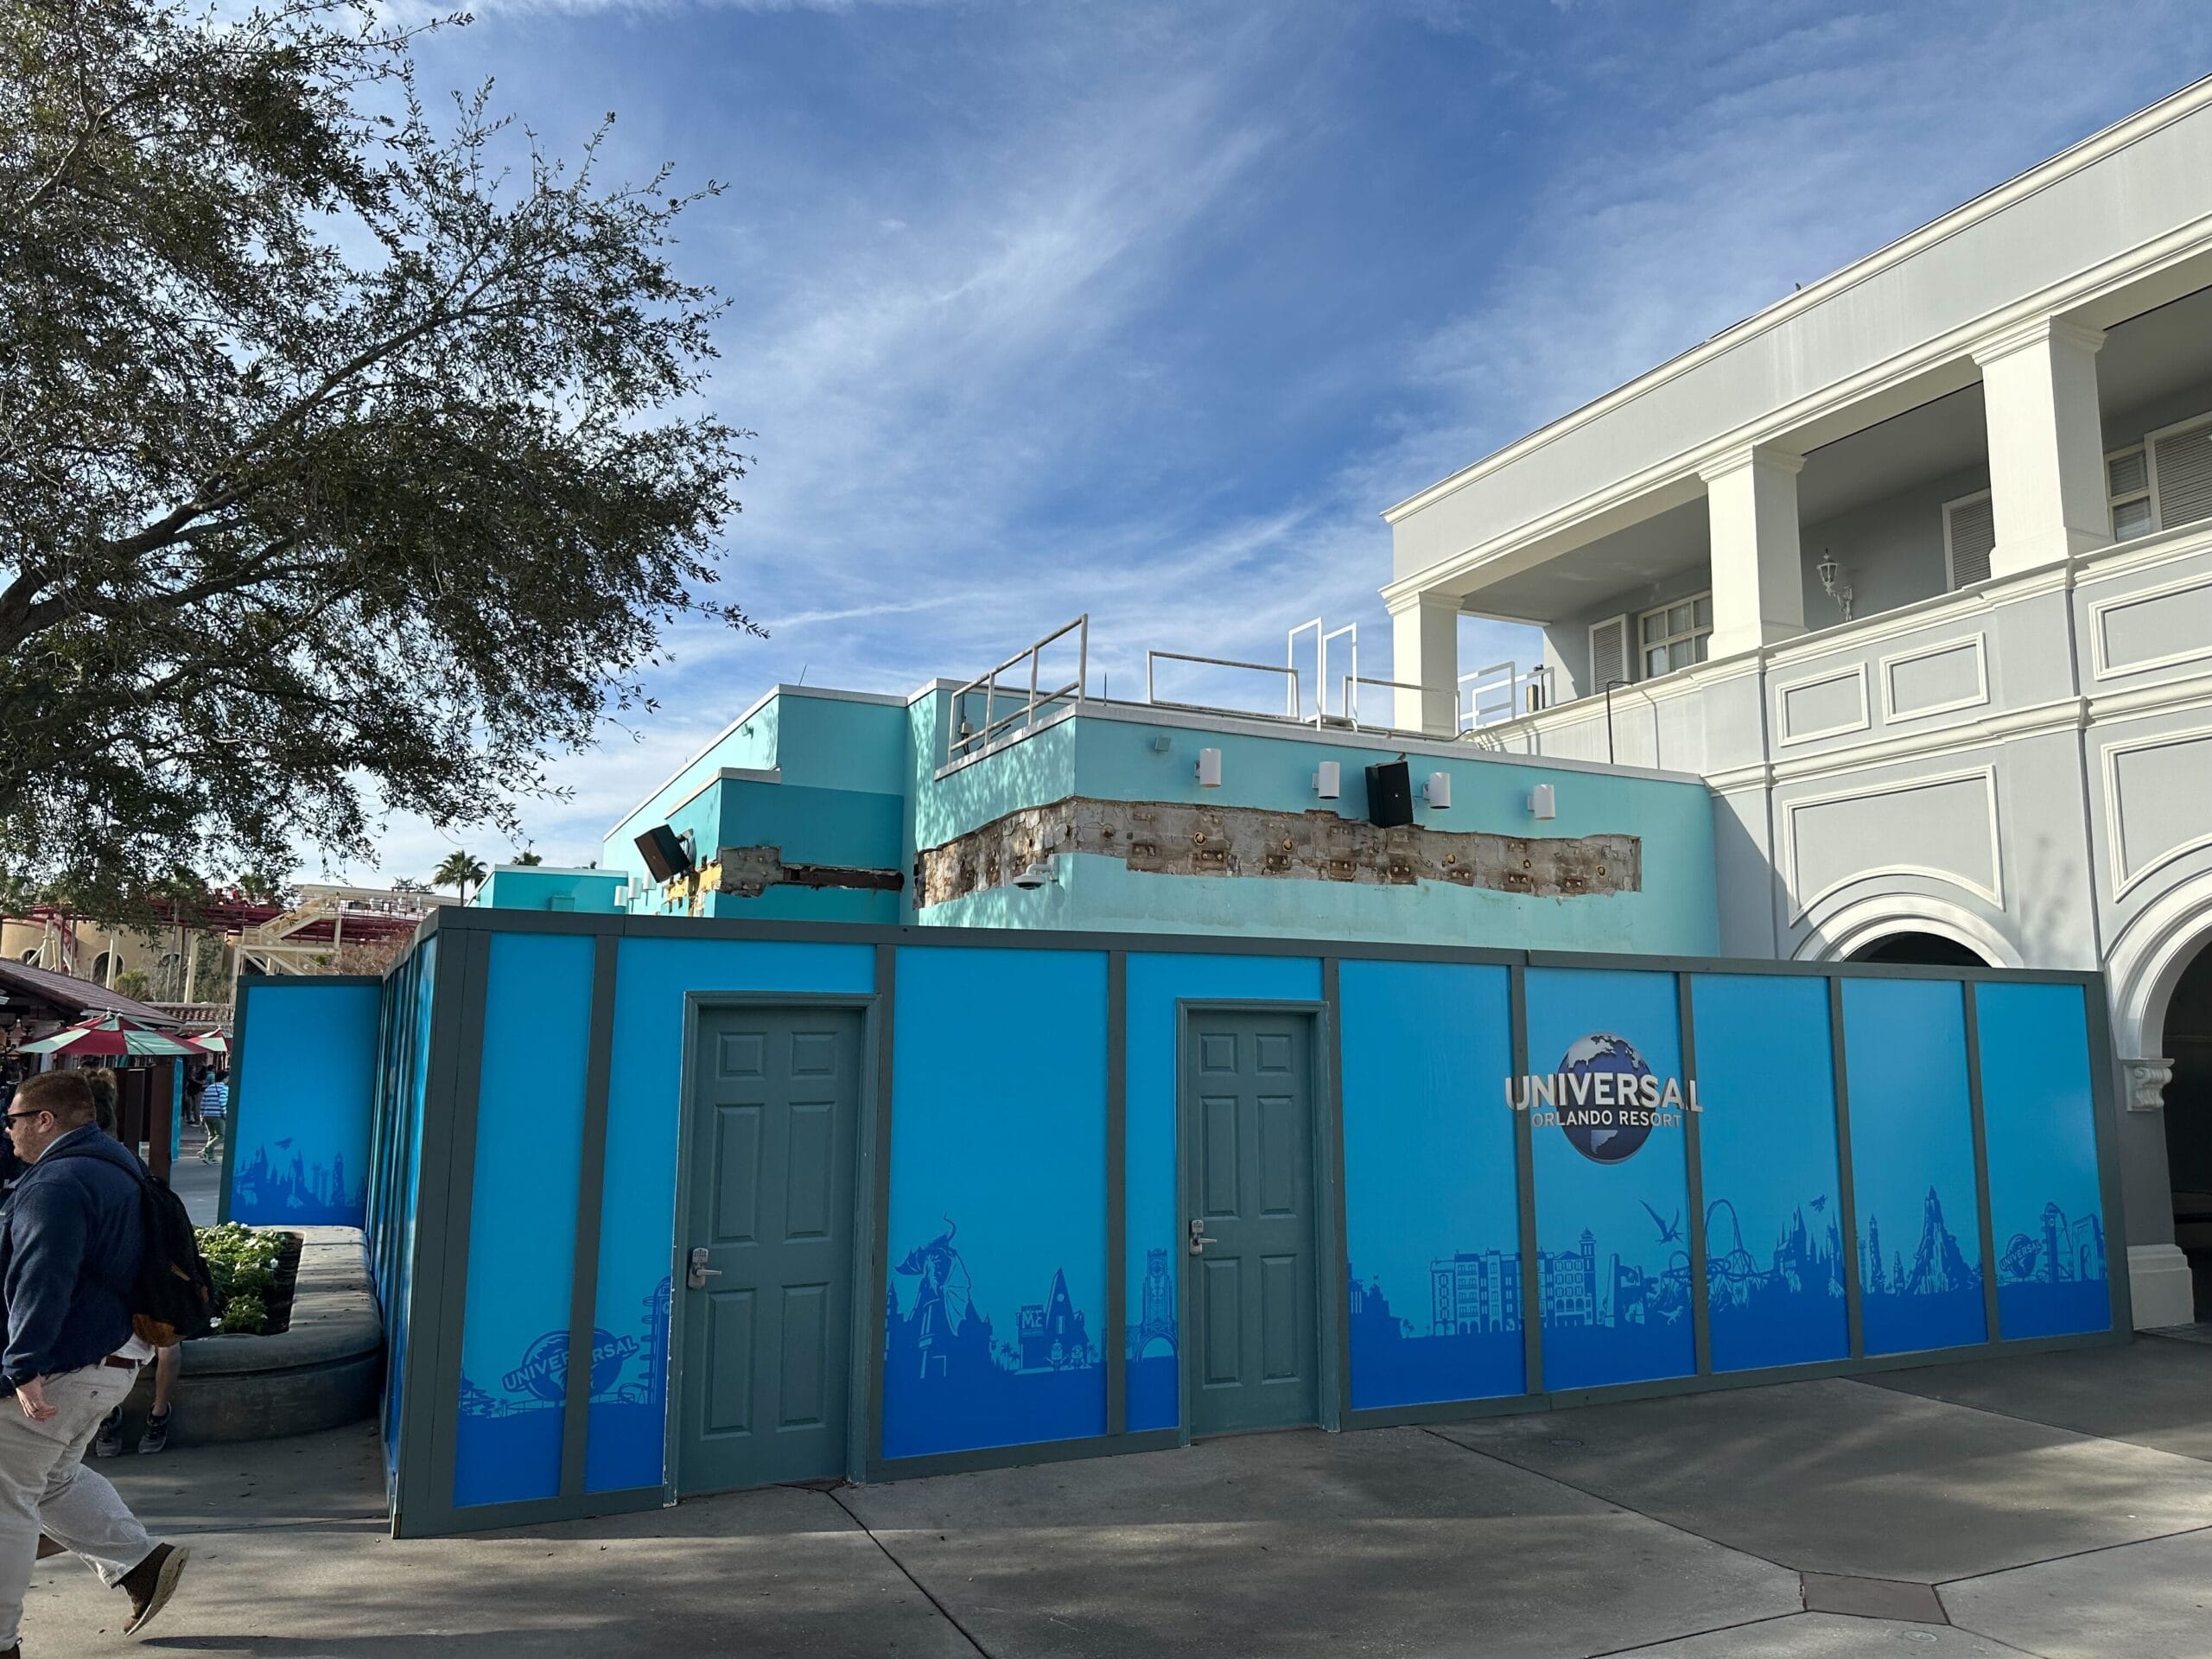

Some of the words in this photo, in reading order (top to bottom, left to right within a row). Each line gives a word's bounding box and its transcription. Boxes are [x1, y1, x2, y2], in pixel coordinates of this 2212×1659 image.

[1504, 1072, 1703, 1112] UNIVERSAL
[1531, 1109, 1613, 1128] ORLANDO
[1619, 1111, 1681, 1128] RESORT
[2000, 1241, 2042, 1269] UNIVERSAL
